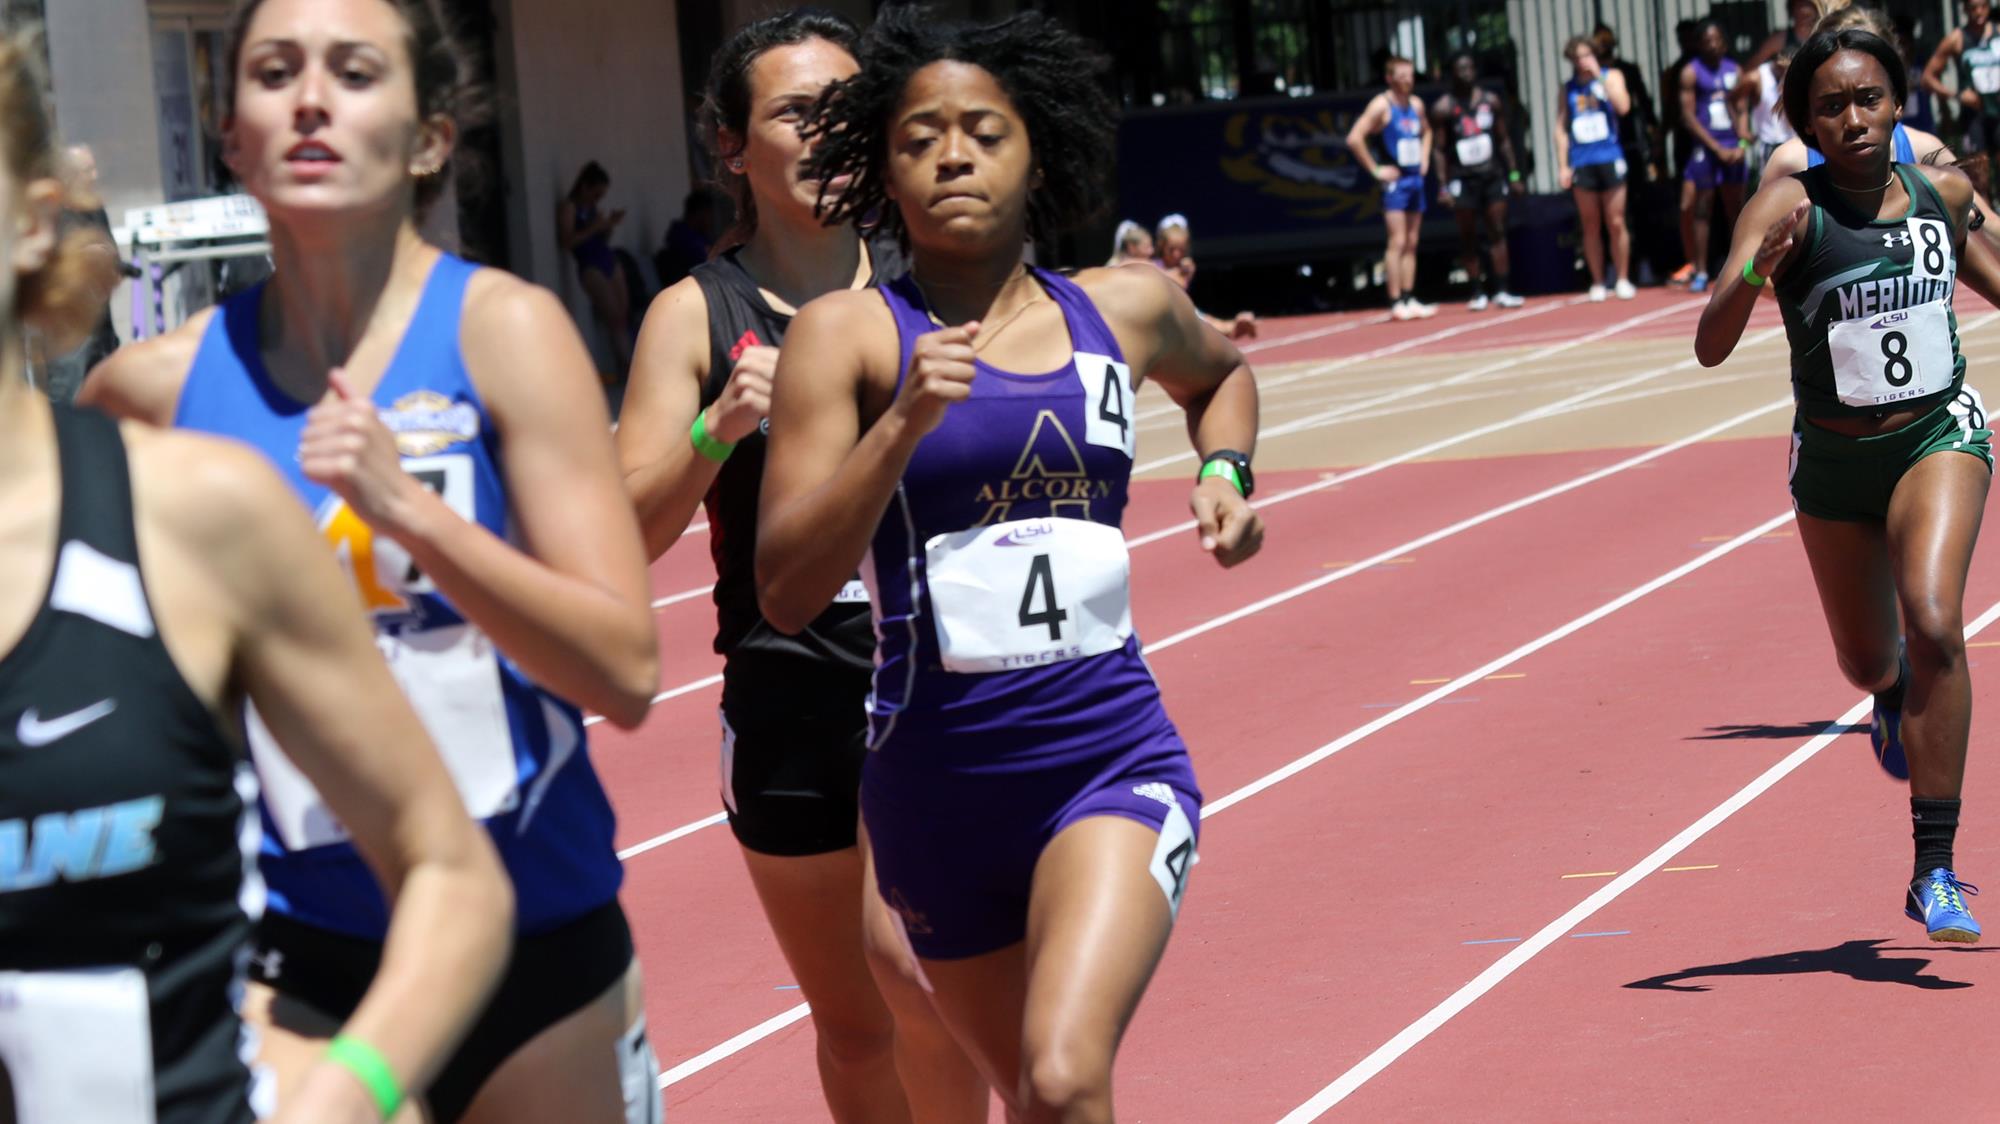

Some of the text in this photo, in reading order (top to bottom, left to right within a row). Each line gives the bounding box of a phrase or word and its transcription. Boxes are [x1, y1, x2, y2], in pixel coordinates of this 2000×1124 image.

[1919, 222, 1945, 276] 8
[1882, 311, 1909, 325] LSU
[1880, 330, 1913, 388] 8
[1099, 363, 1128, 445] 4
[1873, 387, 1926, 404] TIGERS
[1956, 390, 1985, 430] 8
[974, 477, 1116, 503] ALCORN
[1012, 523, 1054, 540] LSU
[1018, 553, 1068, 641] 4
[1000, 644, 1082, 668] TIGERS
[1165, 837, 1192, 900] 4
